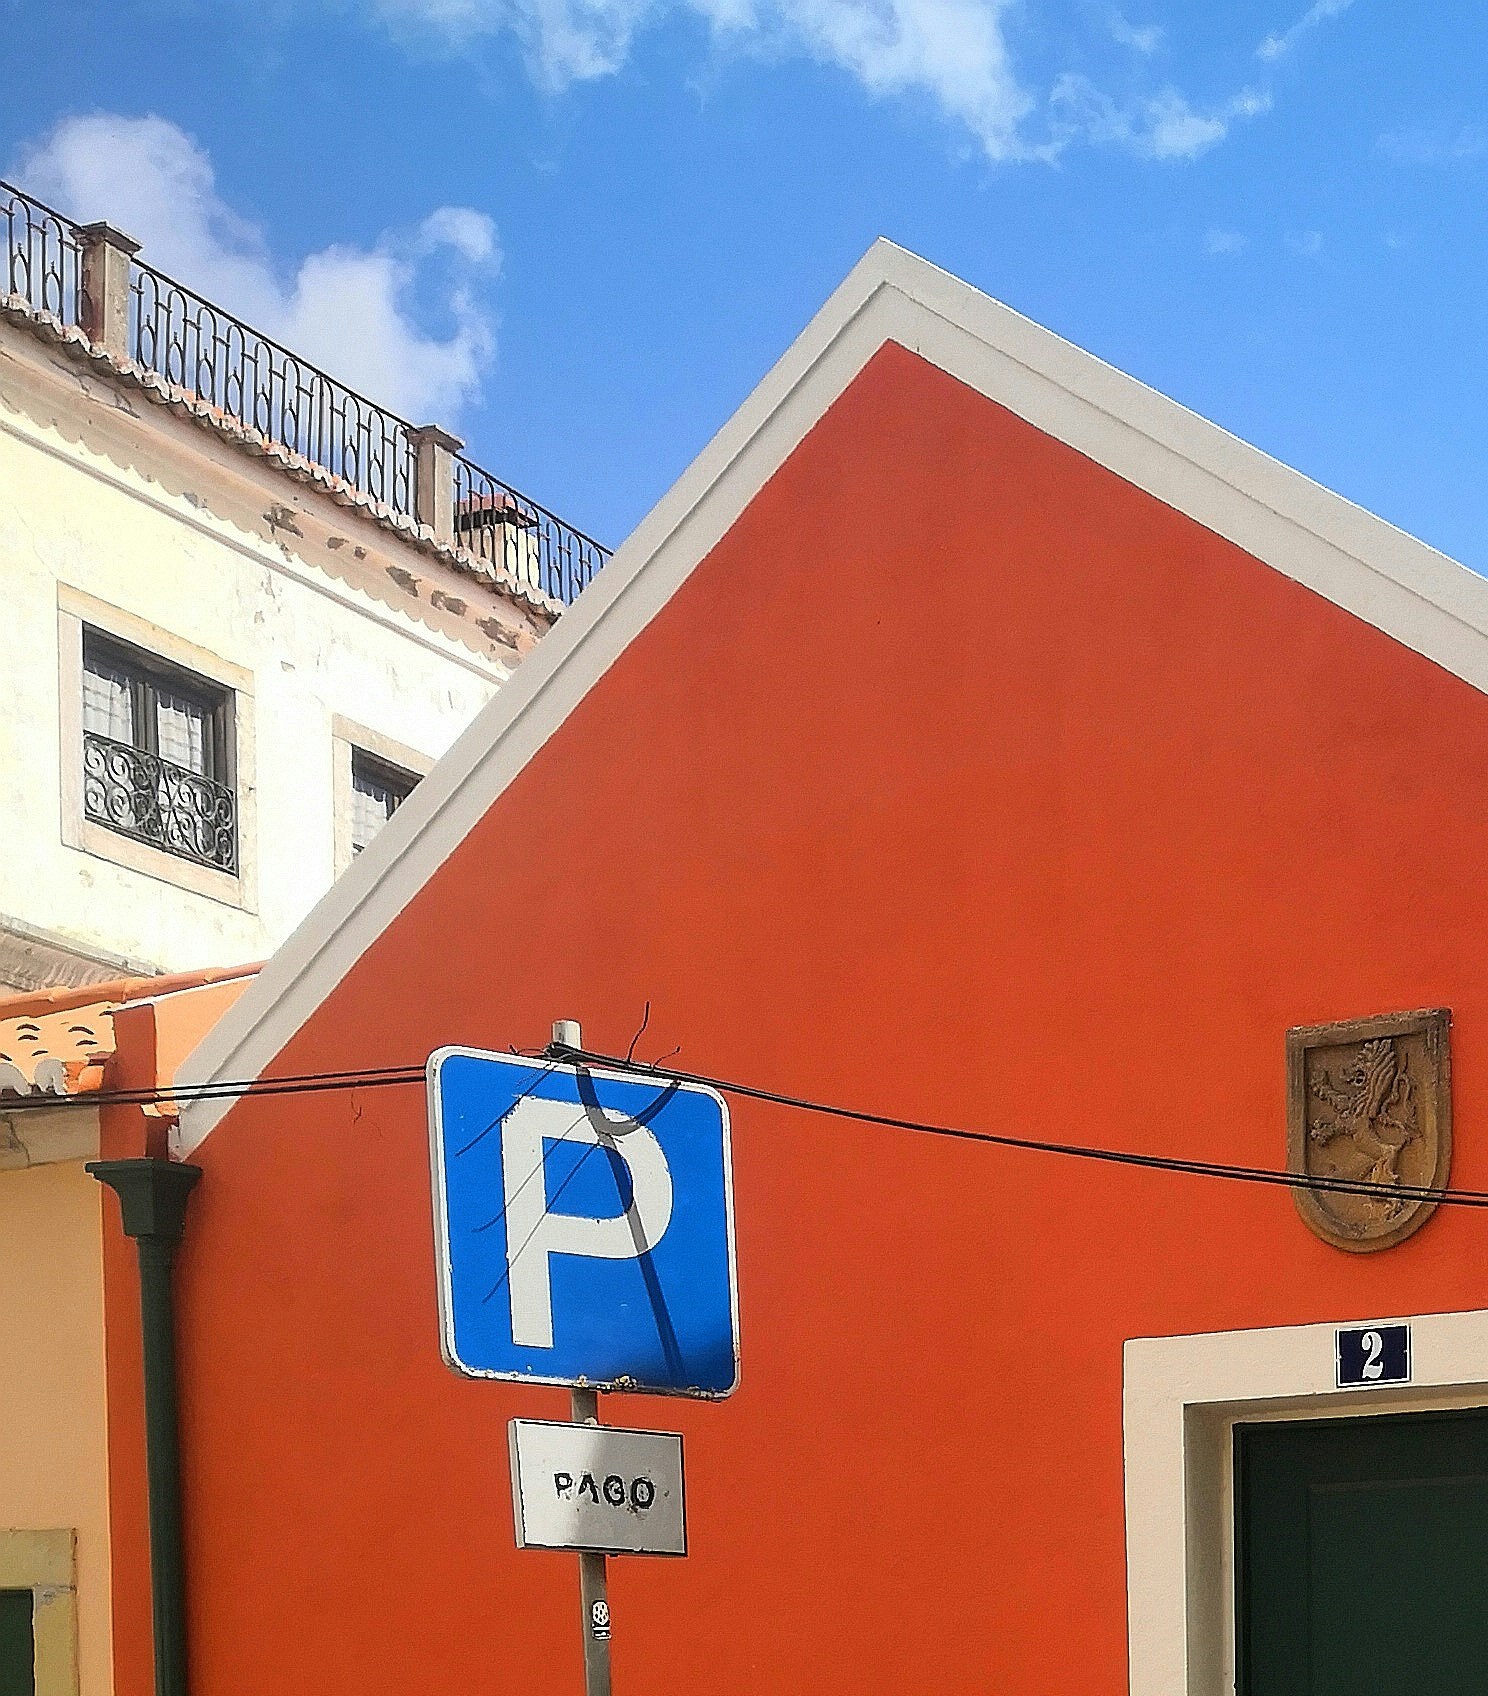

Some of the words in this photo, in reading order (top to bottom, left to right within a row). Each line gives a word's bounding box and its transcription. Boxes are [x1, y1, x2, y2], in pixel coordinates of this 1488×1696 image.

[501, 1094, 674, 1349] P
[1361, 1331, 1384, 1380] 2
[553, 1472, 656, 1510] PAGO
